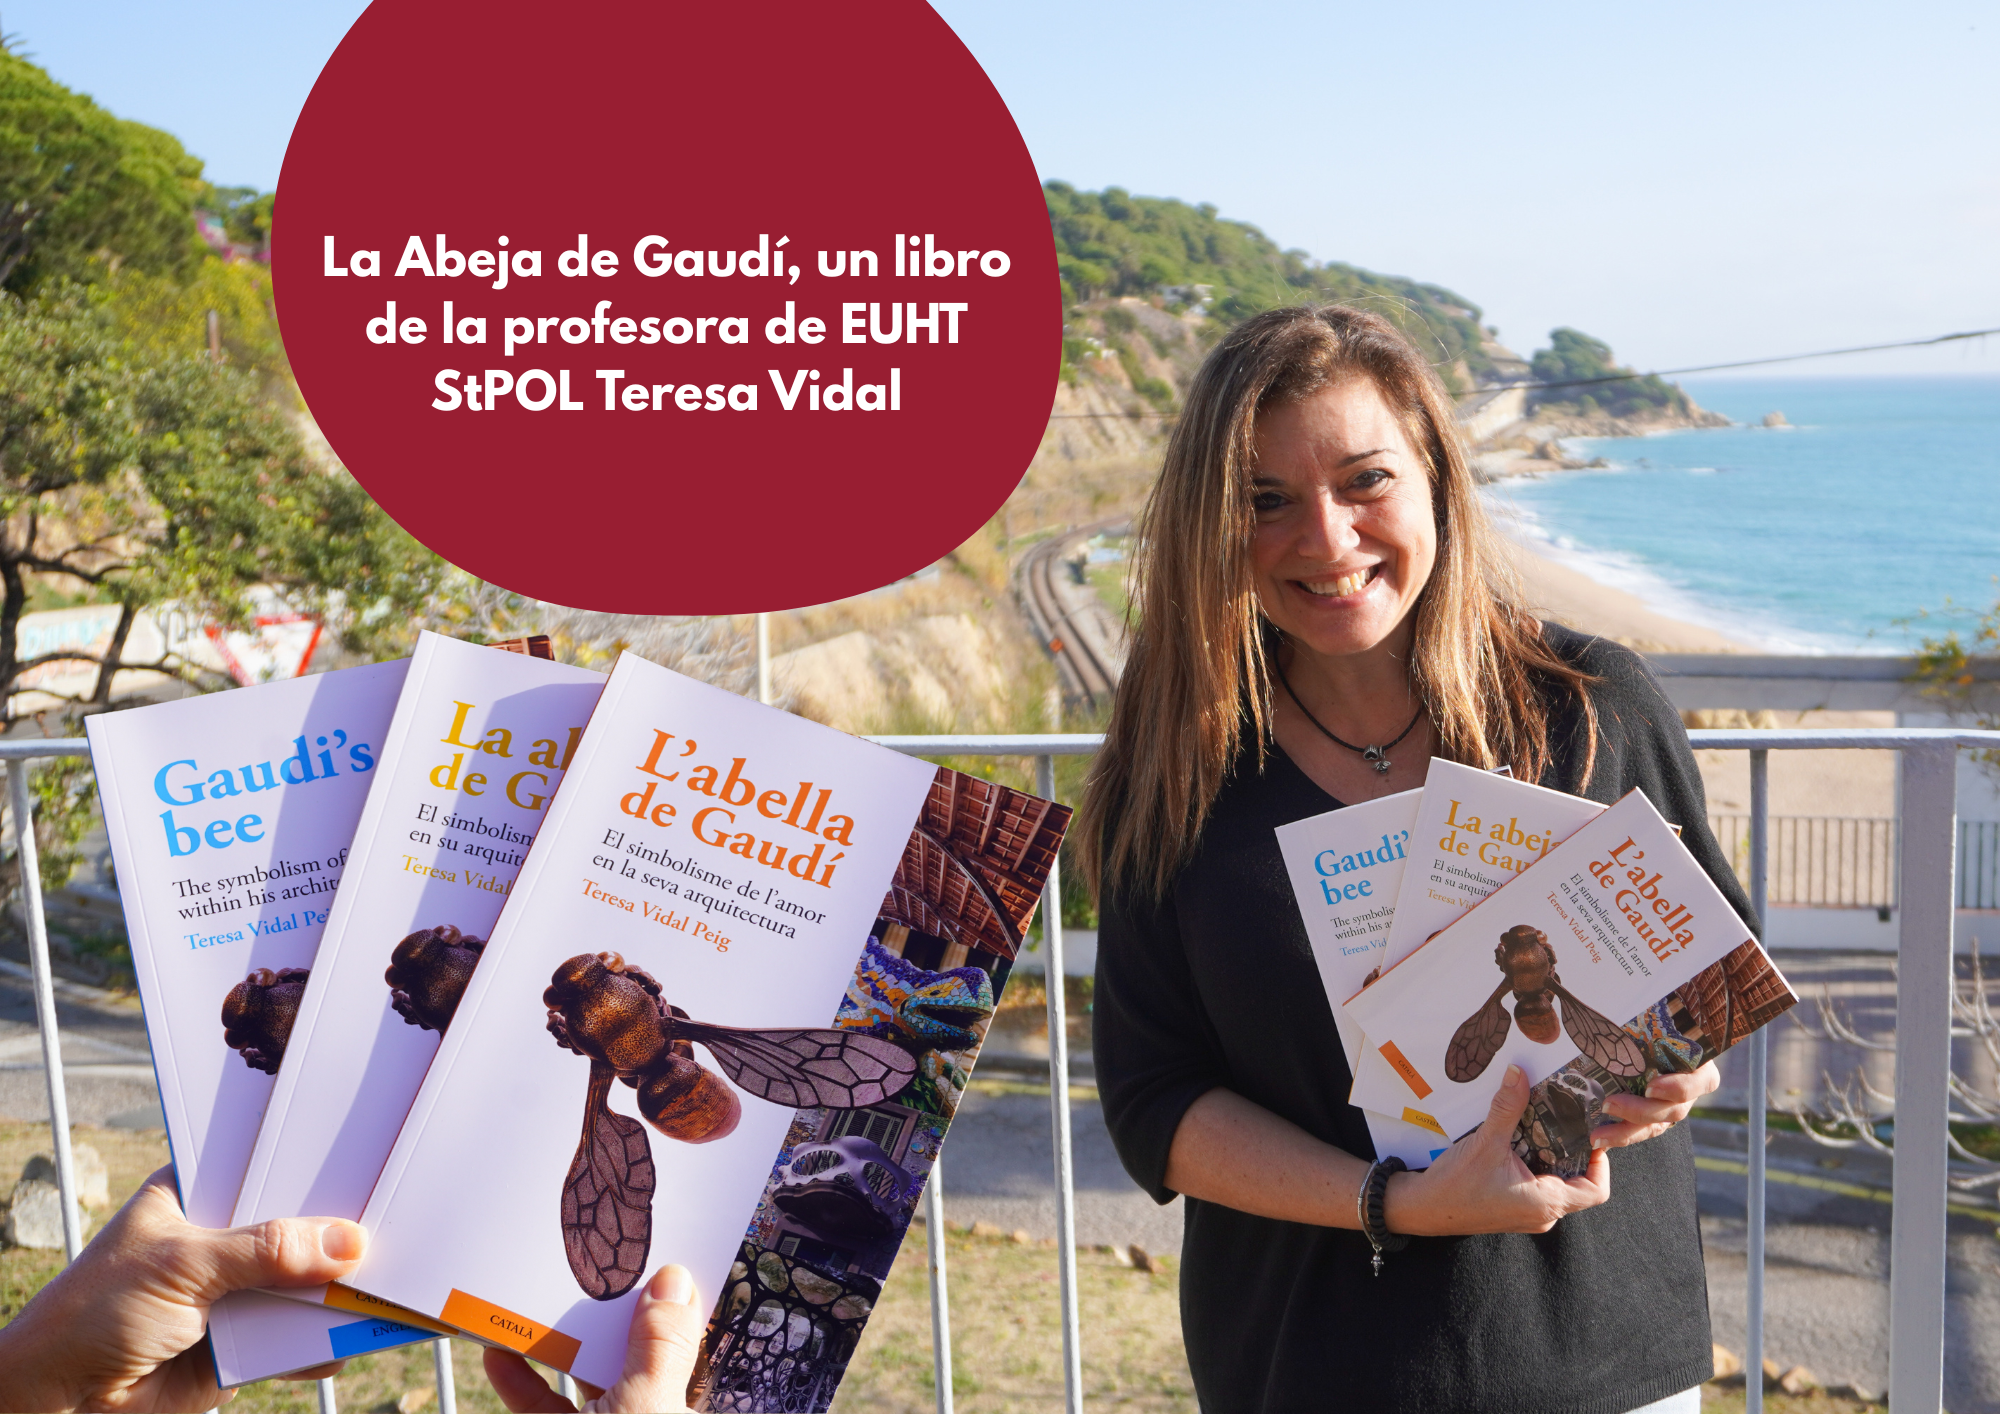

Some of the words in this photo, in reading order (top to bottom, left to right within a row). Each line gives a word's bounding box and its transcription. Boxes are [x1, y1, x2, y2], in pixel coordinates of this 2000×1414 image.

[440, 700, 513, 758] La
[153, 729, 375, 806] Gaudi’s
[429, 753, 488, 796] de
[505, 771, 555, 811] G
[635, 728, 854, 846] L’abella
[159, 809, 265, 858] bee
[416, 802, 438, 824] El
[619, 782, 677, 828] de
[691, 806, 846, 889] Gaudí
[1444, 799, 1482, 834] La
[1489, 817, 1562, 863] abej
[409, 830, 432, 845] en
[437, 835, 458, 851] su
[1439, 830, 1469, 856] de
[172, 878, 212, 898] The
[217, 860, 322, 895] symbolism
[327, 847, 348, 868] of
[402, 854, 457, 883] Teresa
[464, 869, 513, 896] Vidal
[592, 853, 615, 871] en
[620, 858, 636, 880] la
[640, 872, 680, 896] seva
[683, 886, 797, 939] arquitectura
[600, 827, 626, 850] El
[626, 841, 733, 891] simbolisme
[736, 880, 761, 901] de
[764, 887, 827, 925] l’amor
[1319, 878, 1373, 906] bee
[1427, 888, 1456, 906] Teresa
[1430, 874, 1442, 883] en
[1444, 877, 1456, 887] su
[1433, 858, 1445, 871] El
[1446, 864, 1503, 889] simbolismo
[1607, 835, 1694, 950] L’abella
[178, 897, 243, 920] within
[246, 889, 276, 907] his
[582, 877, 636, 913] Teresa
[641, 900, 690, 933] Vidal
[691, 920, 733, 953] Peig
[1330, 916, 1351, 929] The
[1352, 906, 1396, 925] symbolis
[1546, 890, 1569, 920] Teresa
[1567, 917, 1588, 943] Vidal
[1585, 942, 1602, 964] Peig
[1560, 881, 1572, 895] en
[1569, 892, 1580, 905] la
[1576, 903, 1594, 924] seva
[1591, 923, 1635, 977] arquitectura
[1569, 873, 1584, 887] El
[1578, 885, 1620, 936] simbolisme
[1617, 935, 1629, 949] de
[1626, 946, 1652, 978] l’amor
[1588, 860, 1615, 889] de
[1615, 889, 1680, 963] Gaudí
[184, 930, 244, 951] Teresa
[246, 913, 299, 938] Vidal
[1335, 925, 1367, 940] within
[1368, 921, 1383, 934] his
[1339, 945, 1370, 957] Teresa
[489, 1314, 533, 1340] CATALÀ
